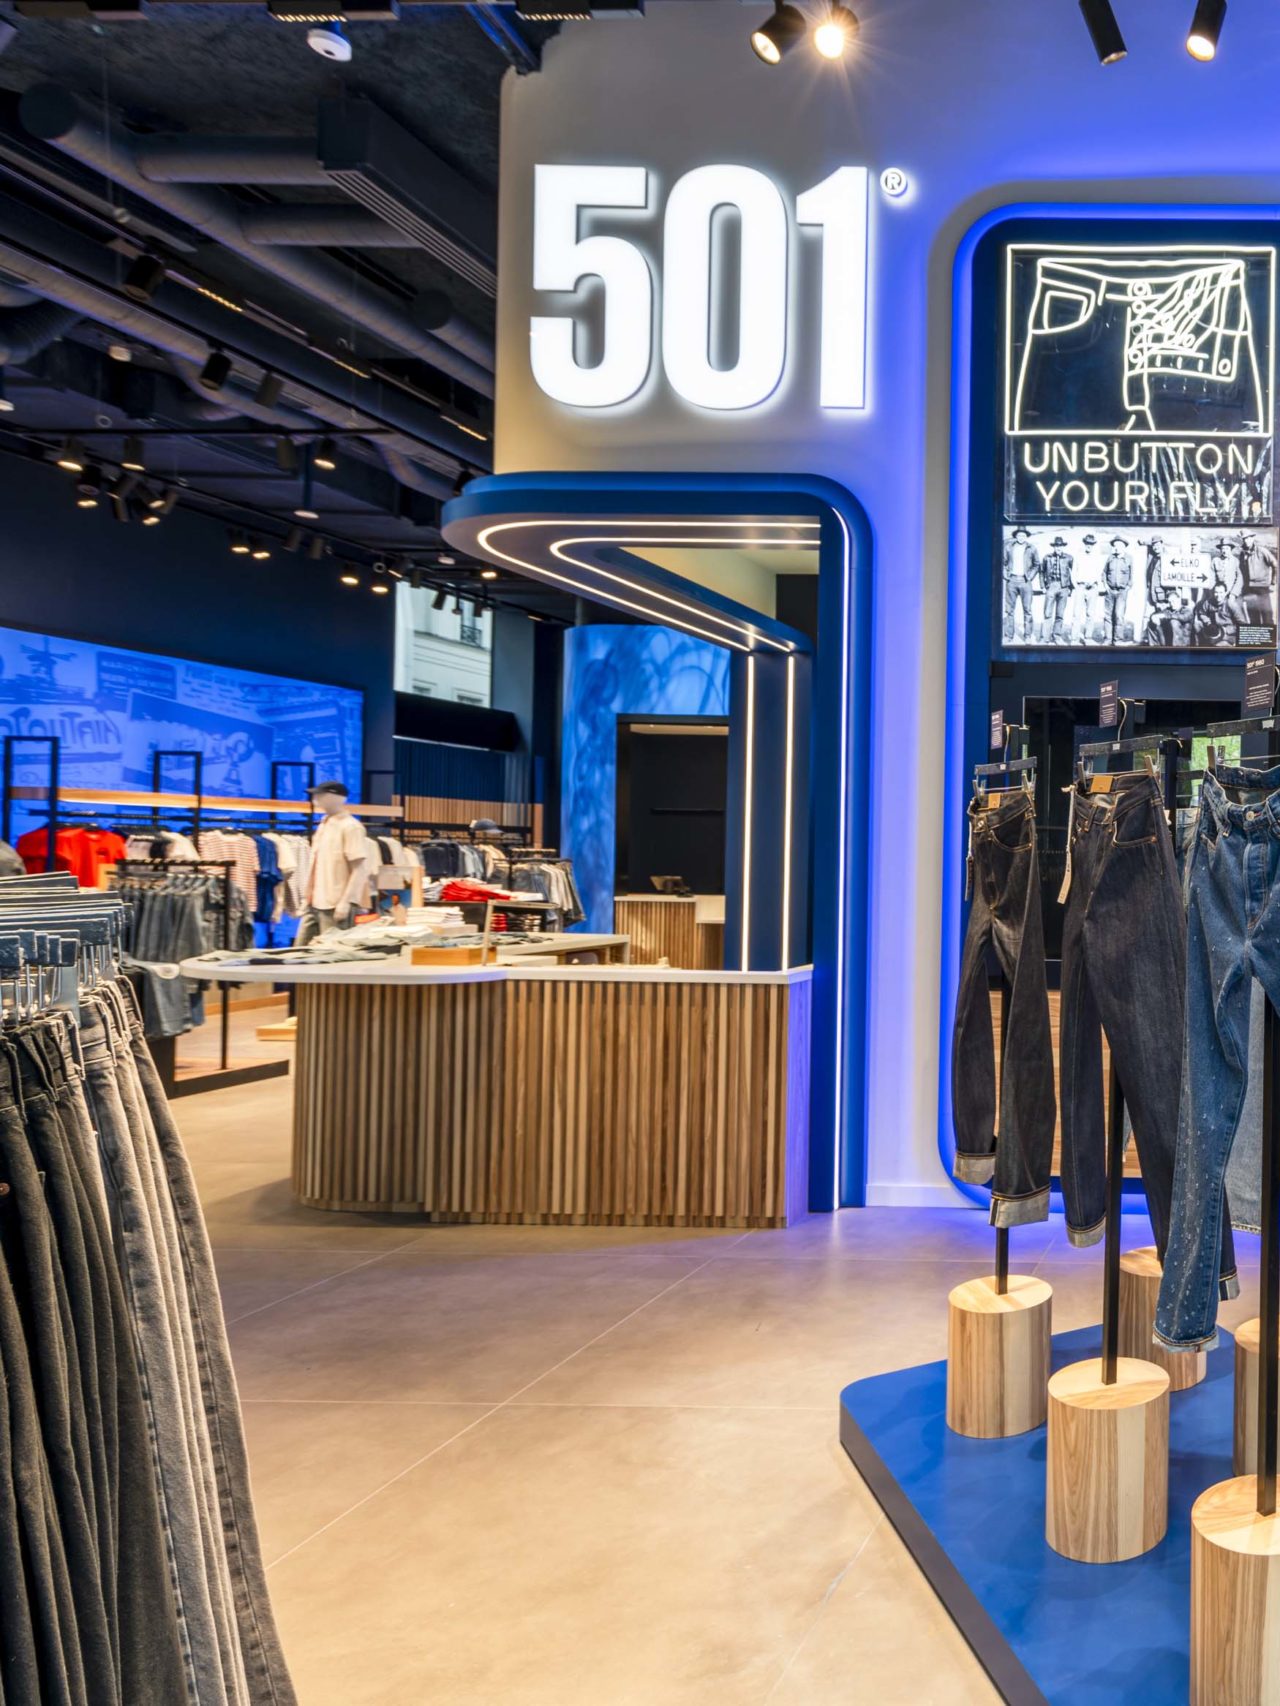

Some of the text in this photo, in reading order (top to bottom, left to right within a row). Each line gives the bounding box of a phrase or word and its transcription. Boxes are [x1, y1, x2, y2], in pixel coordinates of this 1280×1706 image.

[1023, 441, 1254, 475] UNBUTTON
[1035, 480, 1240, 514] YOUR FLY
